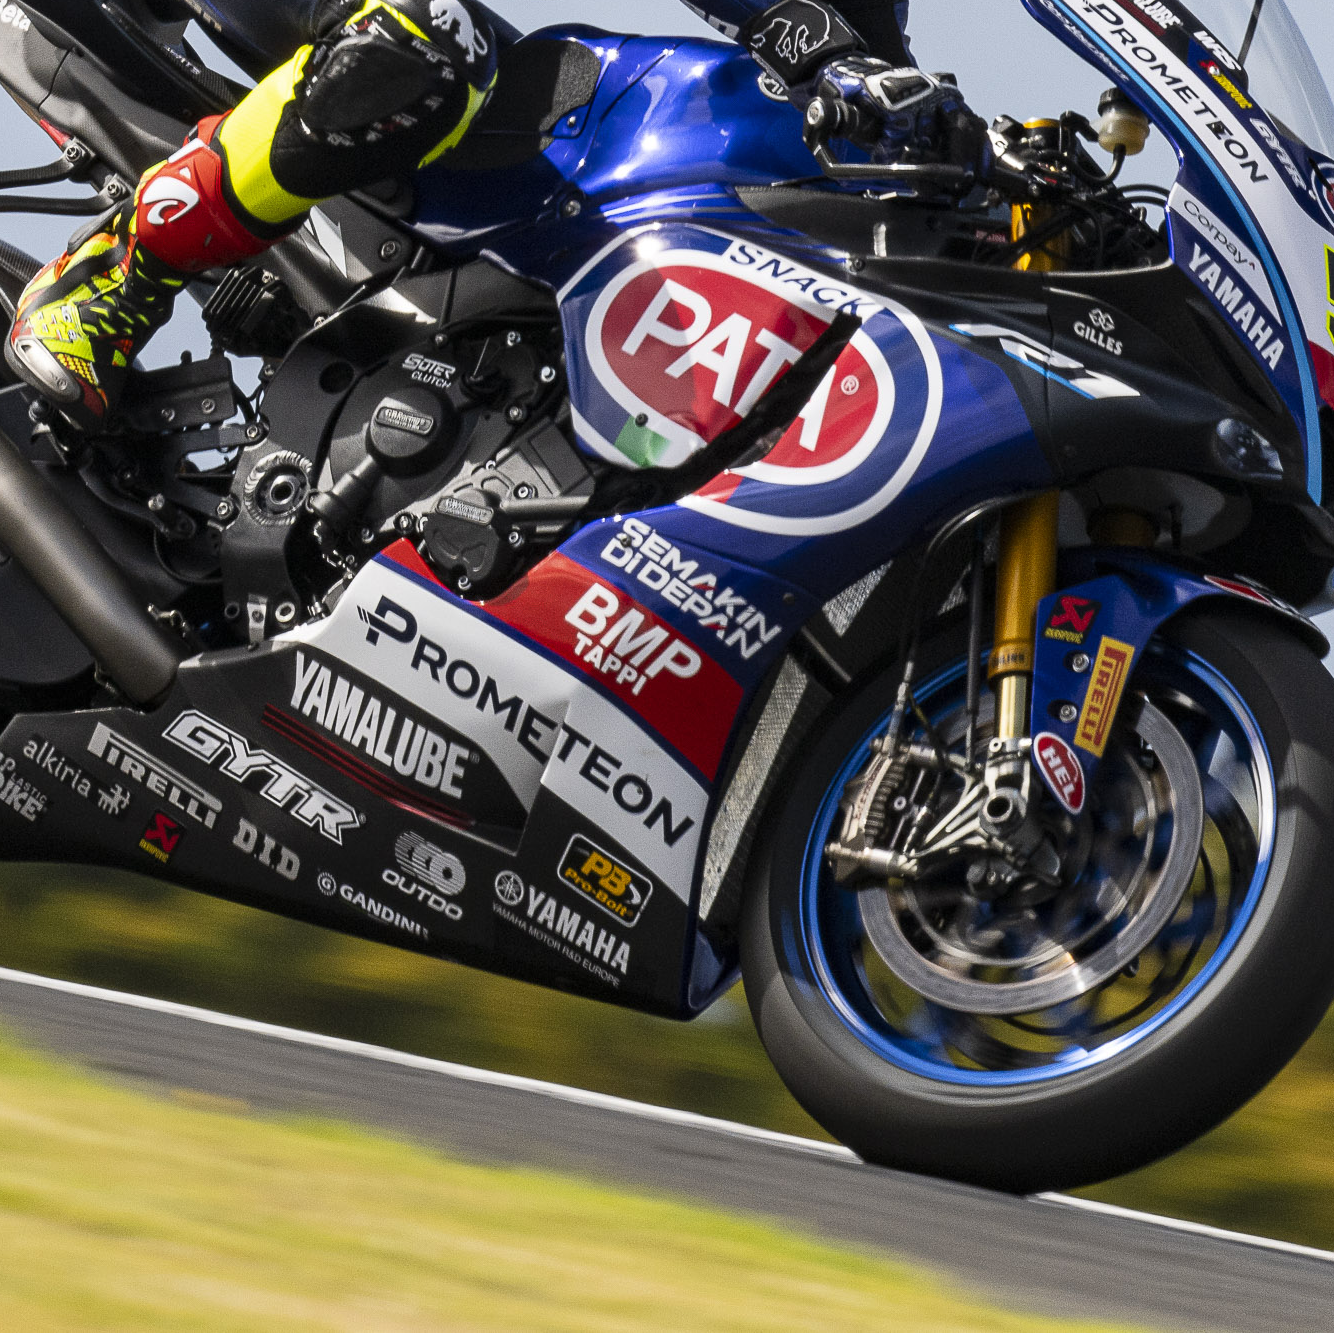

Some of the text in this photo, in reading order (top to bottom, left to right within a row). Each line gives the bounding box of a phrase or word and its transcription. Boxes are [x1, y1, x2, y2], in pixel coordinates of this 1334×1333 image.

[1250, 118, 1307, 190] GYTR
[1184, 200, 1248, 265] Corpay
[730, 244, 875, 314] SNACK
[1188, 243, 1285, 372] YAMAHA
[622, 278, 837, 452] PATA
[1073, 321, 1124, 356] GILLES
[411, 371, 452, 388] CLUTCH
[565, 582, 701, 681] BMP
[638, 561, 764, 660] DEPAN
[574, 633, 645, 696] TAPPI
[1082, 645, 1127, 746] PIRELLI
[290, 652, 465, 799] YAMALUBE
[356, 595, 694, 848] PROMETEON
[23, 740, 91, 798] alkiria
[87, 722, 222, 829] PIRELLI
[163, 708, 360, 846] GYTR
[1041, 746, 1076, 804] HEL
[232, 818, 300, 881] D.I.D
[581, 851, 632, 897] PB
[382, 869, 463, 921] OUTDO
[564, 867, 628, 917] Pro-Bolt
[492, 900, 620, 987] YAMAHA MOTOR R&D EUROPE
[526, 885, 631, 975] YAMAHA
